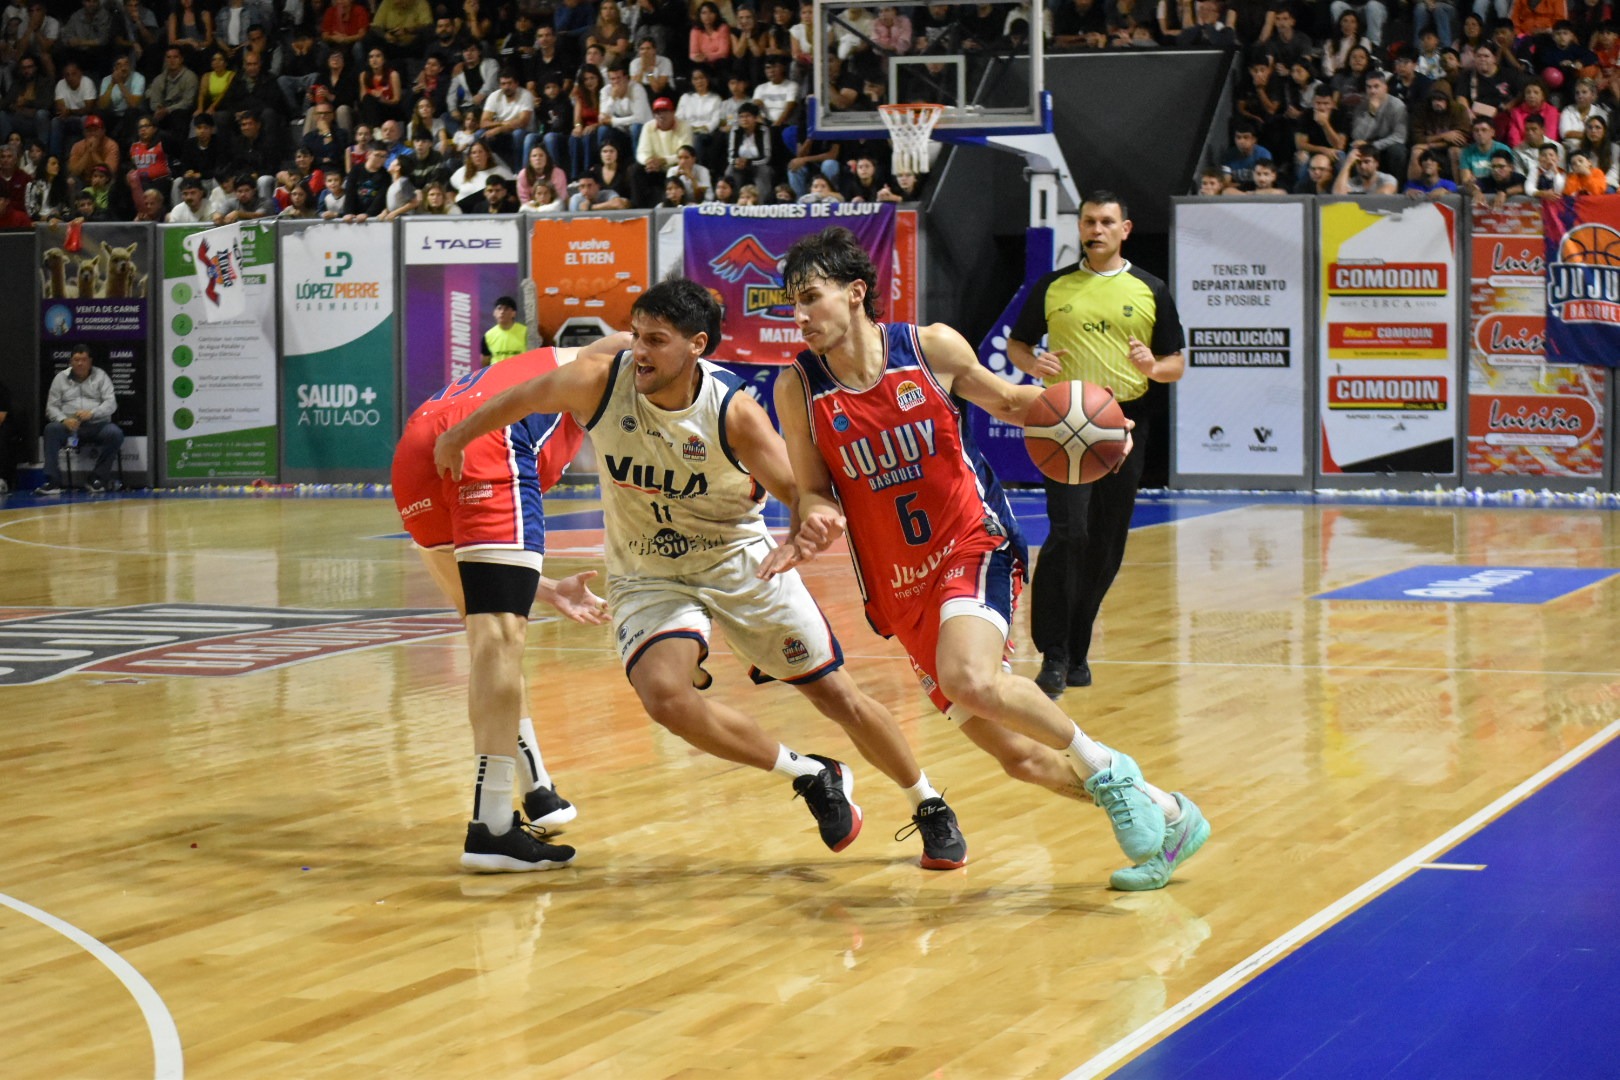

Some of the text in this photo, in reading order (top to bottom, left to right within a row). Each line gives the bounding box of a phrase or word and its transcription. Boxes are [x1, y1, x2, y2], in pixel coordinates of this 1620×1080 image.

[699, 203, 882, 218] LOS CONDORES DE JUJUY
[435, 238, 502, 250] TADE
[568, 238, 611, 250] vuelve
[565, 252, 615, 266] EL TREN
[1492, 242, 1546, 273] Luis
[1211, 264, 1266, 276] TENER TU
[1335, 268, 1439, 289] COMODIN
[1192, 279, 1286, 291] DEPARTAMENTO
[1554, 267, 1620, 301] JUJU
[76, 305, 140, 313] VENTA DE CARNE
[296, 302, 380, 311] FARMACIA
[1207, 295, 1271, 307] ES POSIBLE
[1360, 299, 1412, 308] CERCA
[450, 290, 472, 347] MOTION
[1569, 303, 1620, 321] BASQUE
[760, 327, 803, 343] MATIA
[1194, 328, 1285, 345] REVOLUCIÓN
[1376, 327, 1433, 339] COMODIN
[1491, 321, 1546, 352] Luis
[450, 345, 472, 362] IN
[1194, 352, 1285, 365] INMOBILIARIA
[297, 384, 358, 408] SALUD
[1336, 379, 1440, 401] COMODIN
[297, 409, 380, 426] A TU LADO
[1488, 399, 1582, 432] Luisiño
[989, 427, 1001, 438] DE
[839, 418, 937, 481] JUJUY
[604, 454, 709, 497] VILLA
[868, 464, 924, 492] BASQUET
[650, 501, 674, 524] 11
[894, 491, 933, 547] 6
